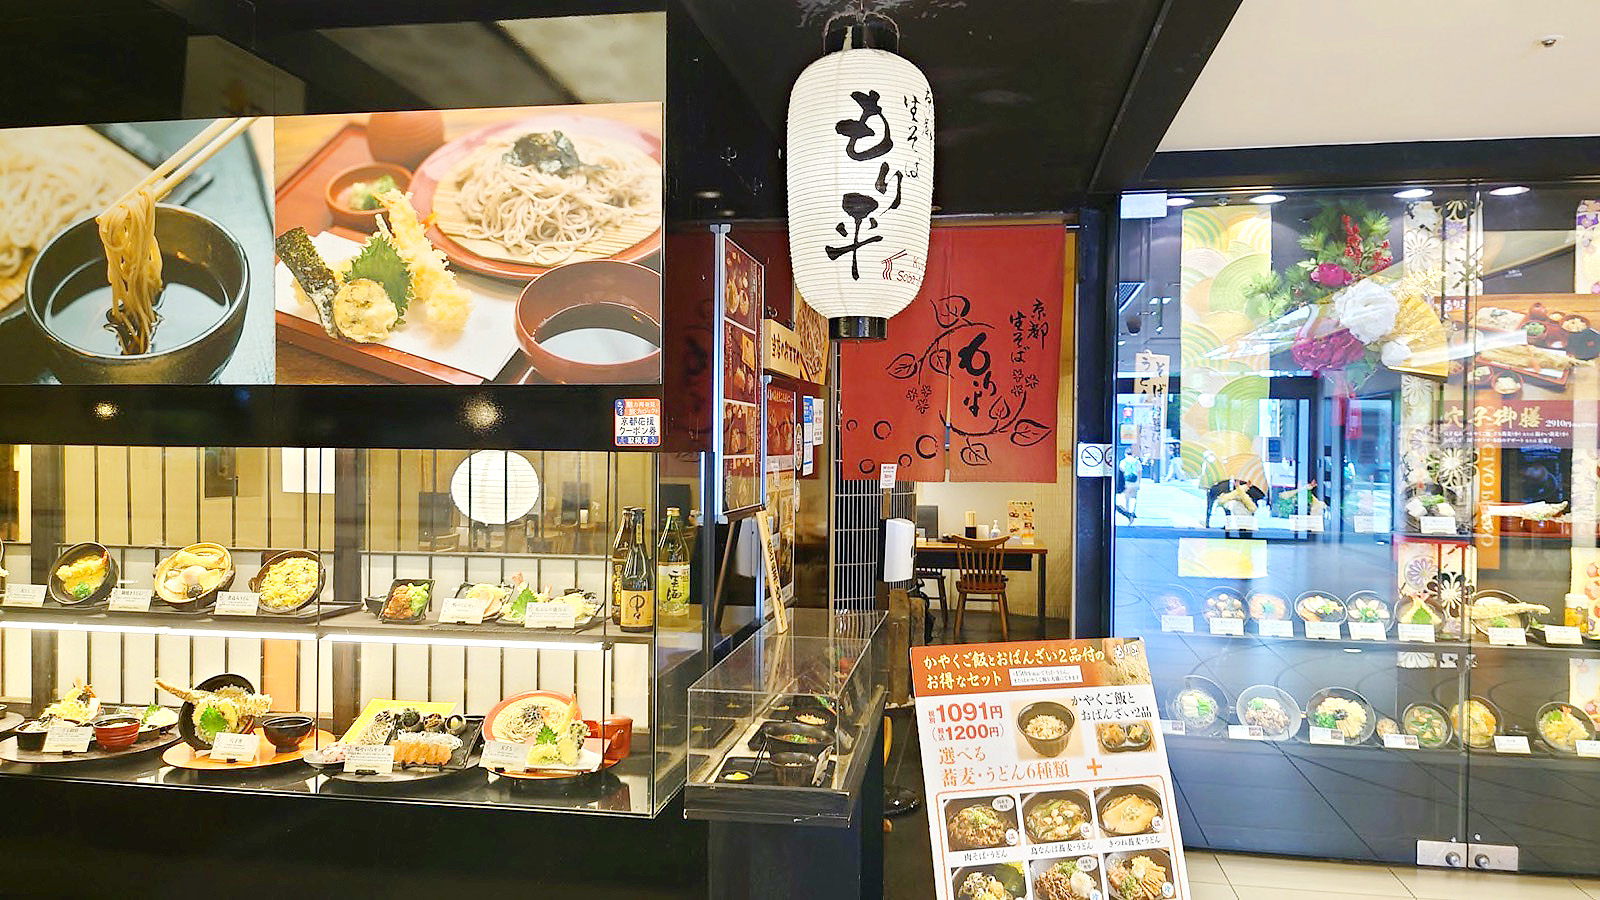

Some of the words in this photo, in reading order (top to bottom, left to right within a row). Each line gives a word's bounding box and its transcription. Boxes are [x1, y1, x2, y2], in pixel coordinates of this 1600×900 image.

[825, 90, 904, 281] もり平
[1028, 298, 1049, 350] 京都
[620, 416, 655, 426] 京都応援
[619, 426, 657, 436] クーポン券
[923, 644, 1105, 670] かやくご飯とおばんざい2品付の
[926, 671, 1002, 691] お得なセット
[1071, 691, 1136, 707] かやくご飯と
[1081, 705, 1152, 721] おばんざい2品
[939, 746, 986, 765] 選べる
[942, 759, 1071, 788] 蕎麦・うどん6種類
